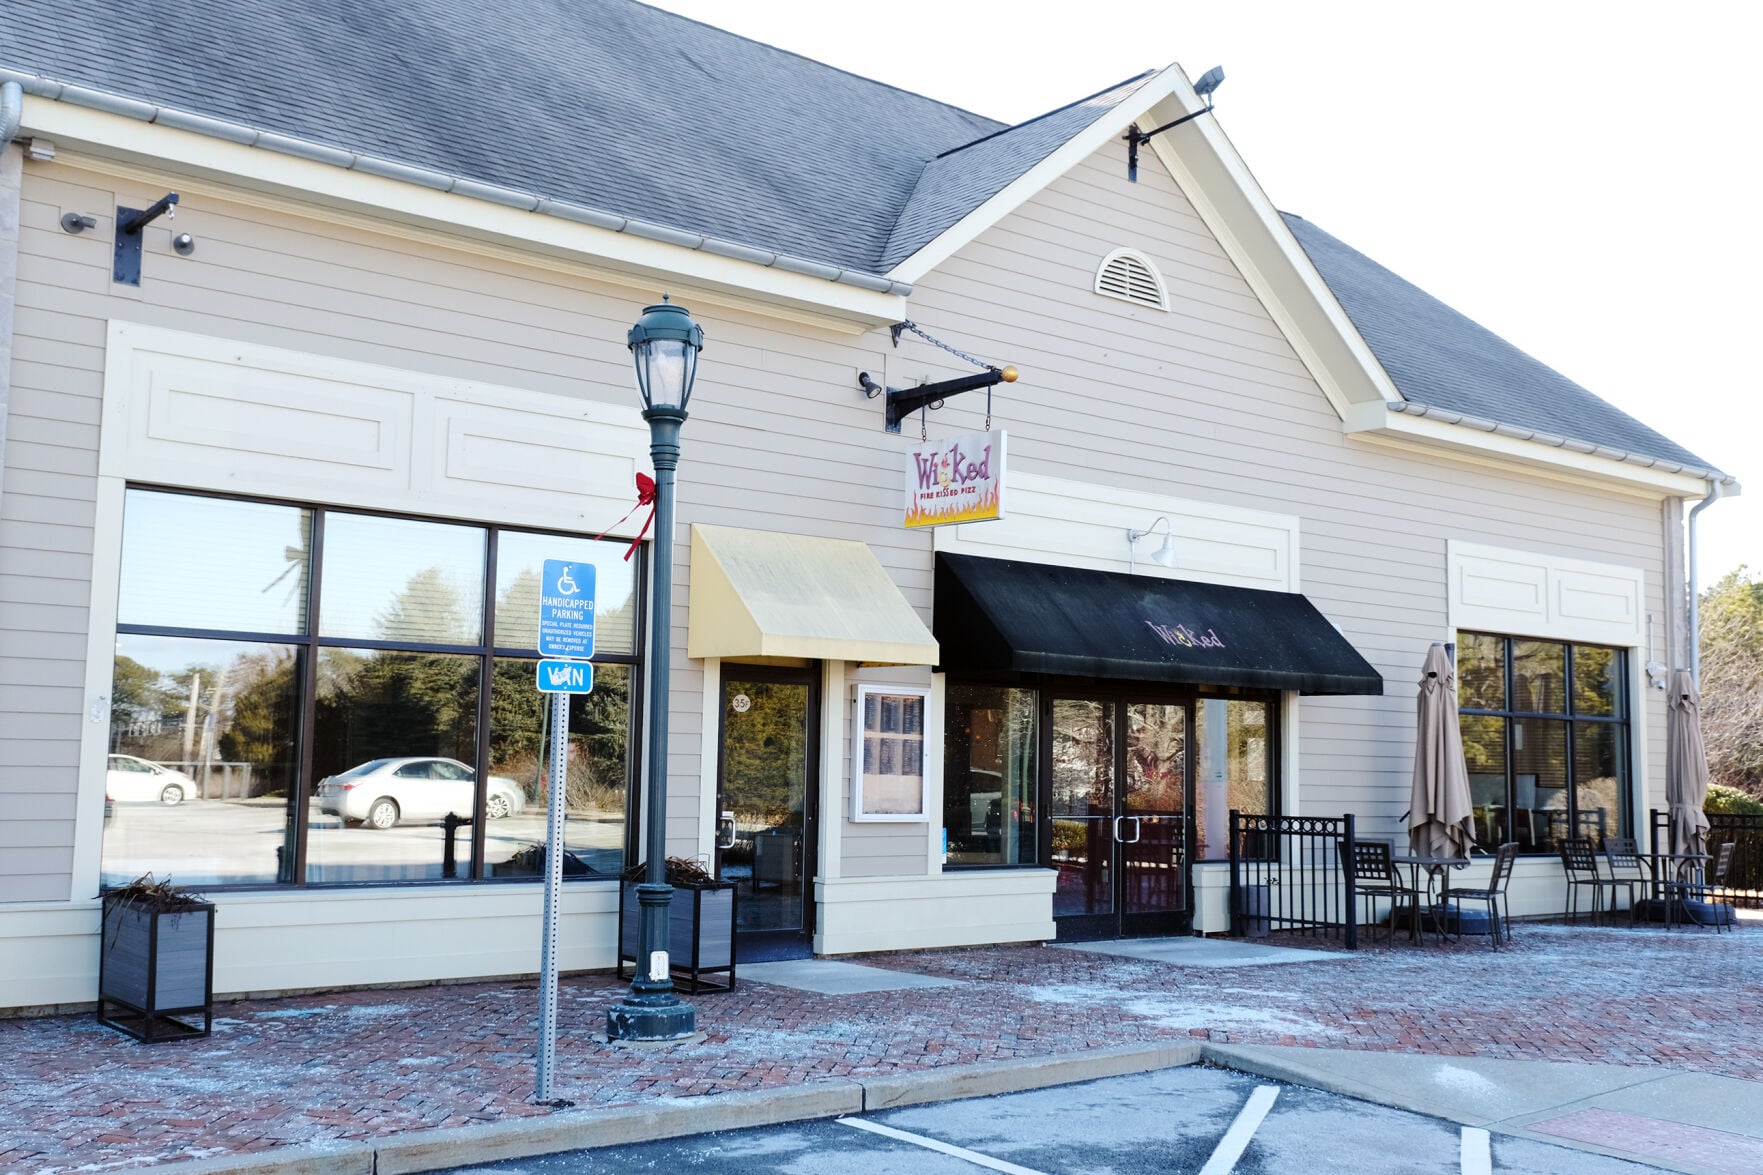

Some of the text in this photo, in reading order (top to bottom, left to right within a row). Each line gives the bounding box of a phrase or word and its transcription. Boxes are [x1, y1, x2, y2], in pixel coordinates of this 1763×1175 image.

[920, 492, 934, 500] FIRE
[936, 487, 958, 498] KISSED
[542, 596, 594, 610] HANDICAPPED
[551, 608, 584, 621] PARKING
